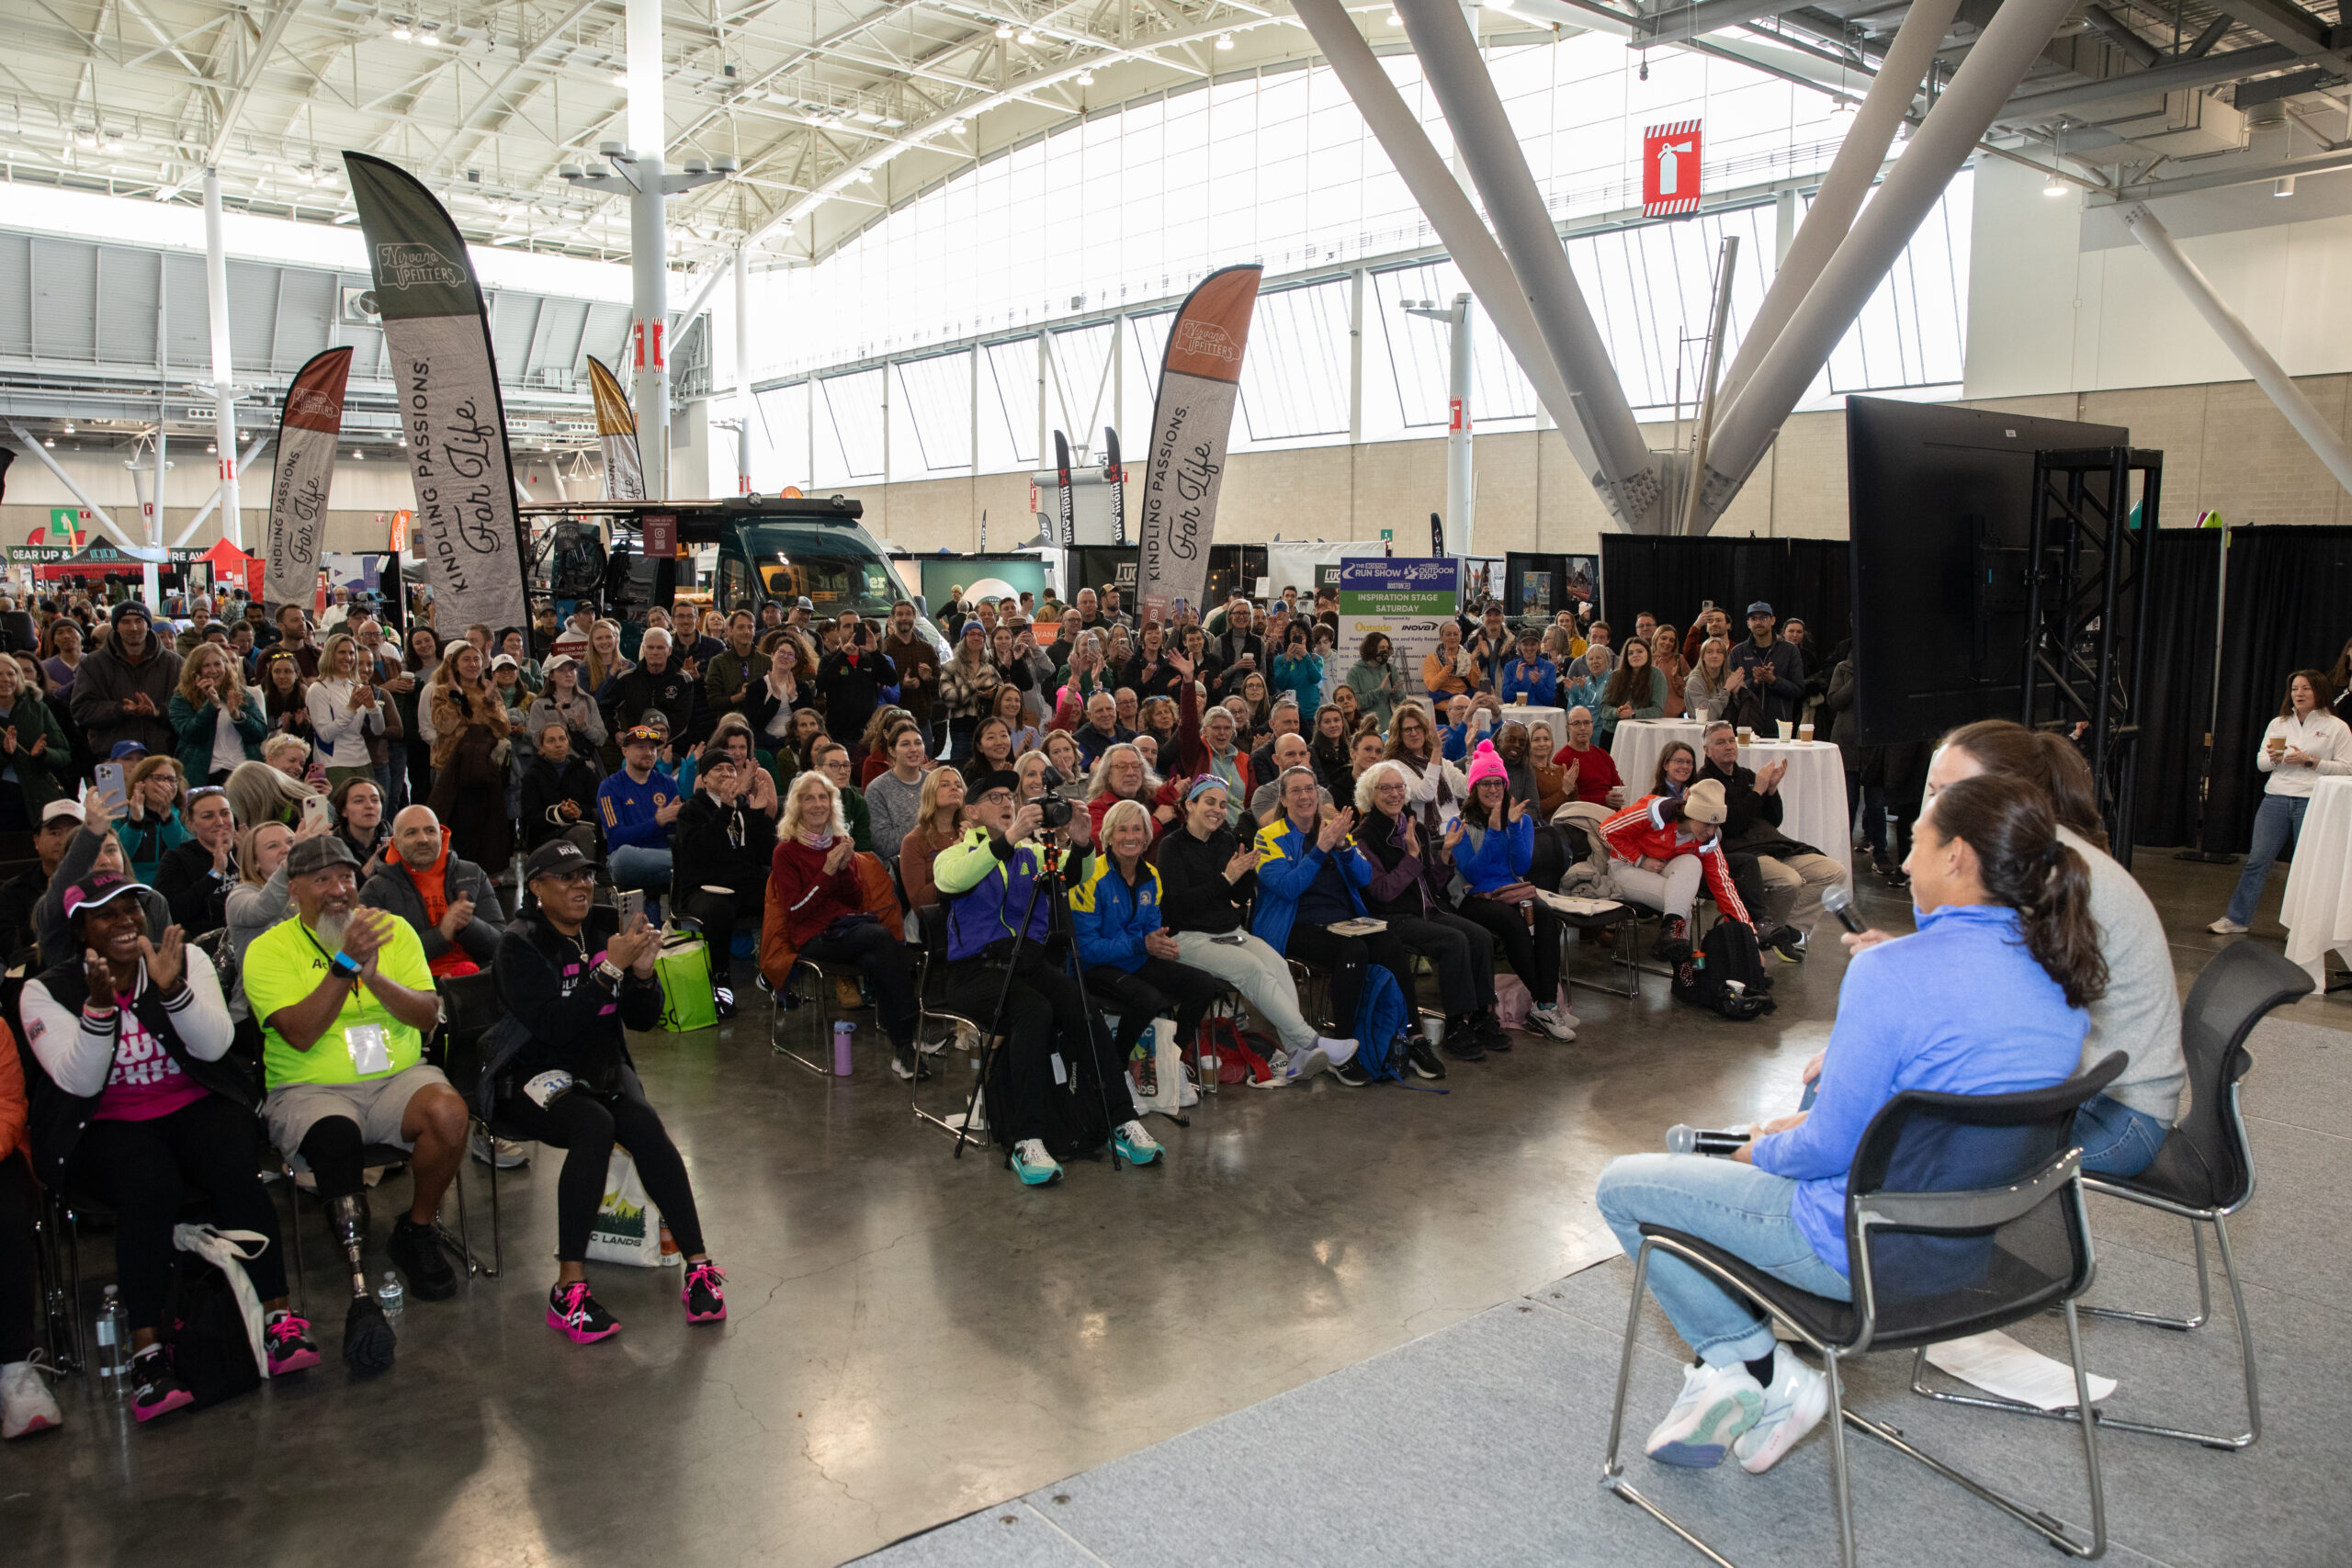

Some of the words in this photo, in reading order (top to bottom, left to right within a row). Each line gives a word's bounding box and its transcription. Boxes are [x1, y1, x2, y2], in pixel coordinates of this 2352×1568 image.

[381, 246, 439, 268] Nirvana
[396, 266, 456, 287] UPFITTERS
[1188, 339, 1232, 359] UPFITTERS
[413, 356, 434, 478] PASSIONS.
[443, 396, 495, 479] Life.
[1152, 405, 1190, 491] PASSIONS.
[1177, 441, 1219, 502] Life.
[277, 449, 302, 513] PASSIONS.
[294, 475, 326, 520] Life.
[1113, 481, 1123, 541] HIGHLAND
[423, 487, 469, 592] KINDLING
[1062, 485, 1072, 545] HIGHLAND
[1148, 499, 1161, 581] KINDLING
[13, 549, 40, 560] GEAR
[41, 549, 60, 560] UP
[62, 549, 71, 560] &
[273, 518, 285, 579] KINDLING
[1355, 569, 1374, 577] RUN
[1374, 569, 1402, 578] SHOW
[1358, 593, 1409, 602] INSPIRATION
[1411, 593, 1438, 602] STAGE
[1375, 604, 1419, 613] SATURDAY
[603, 1235, 642, 1247] LANDS
